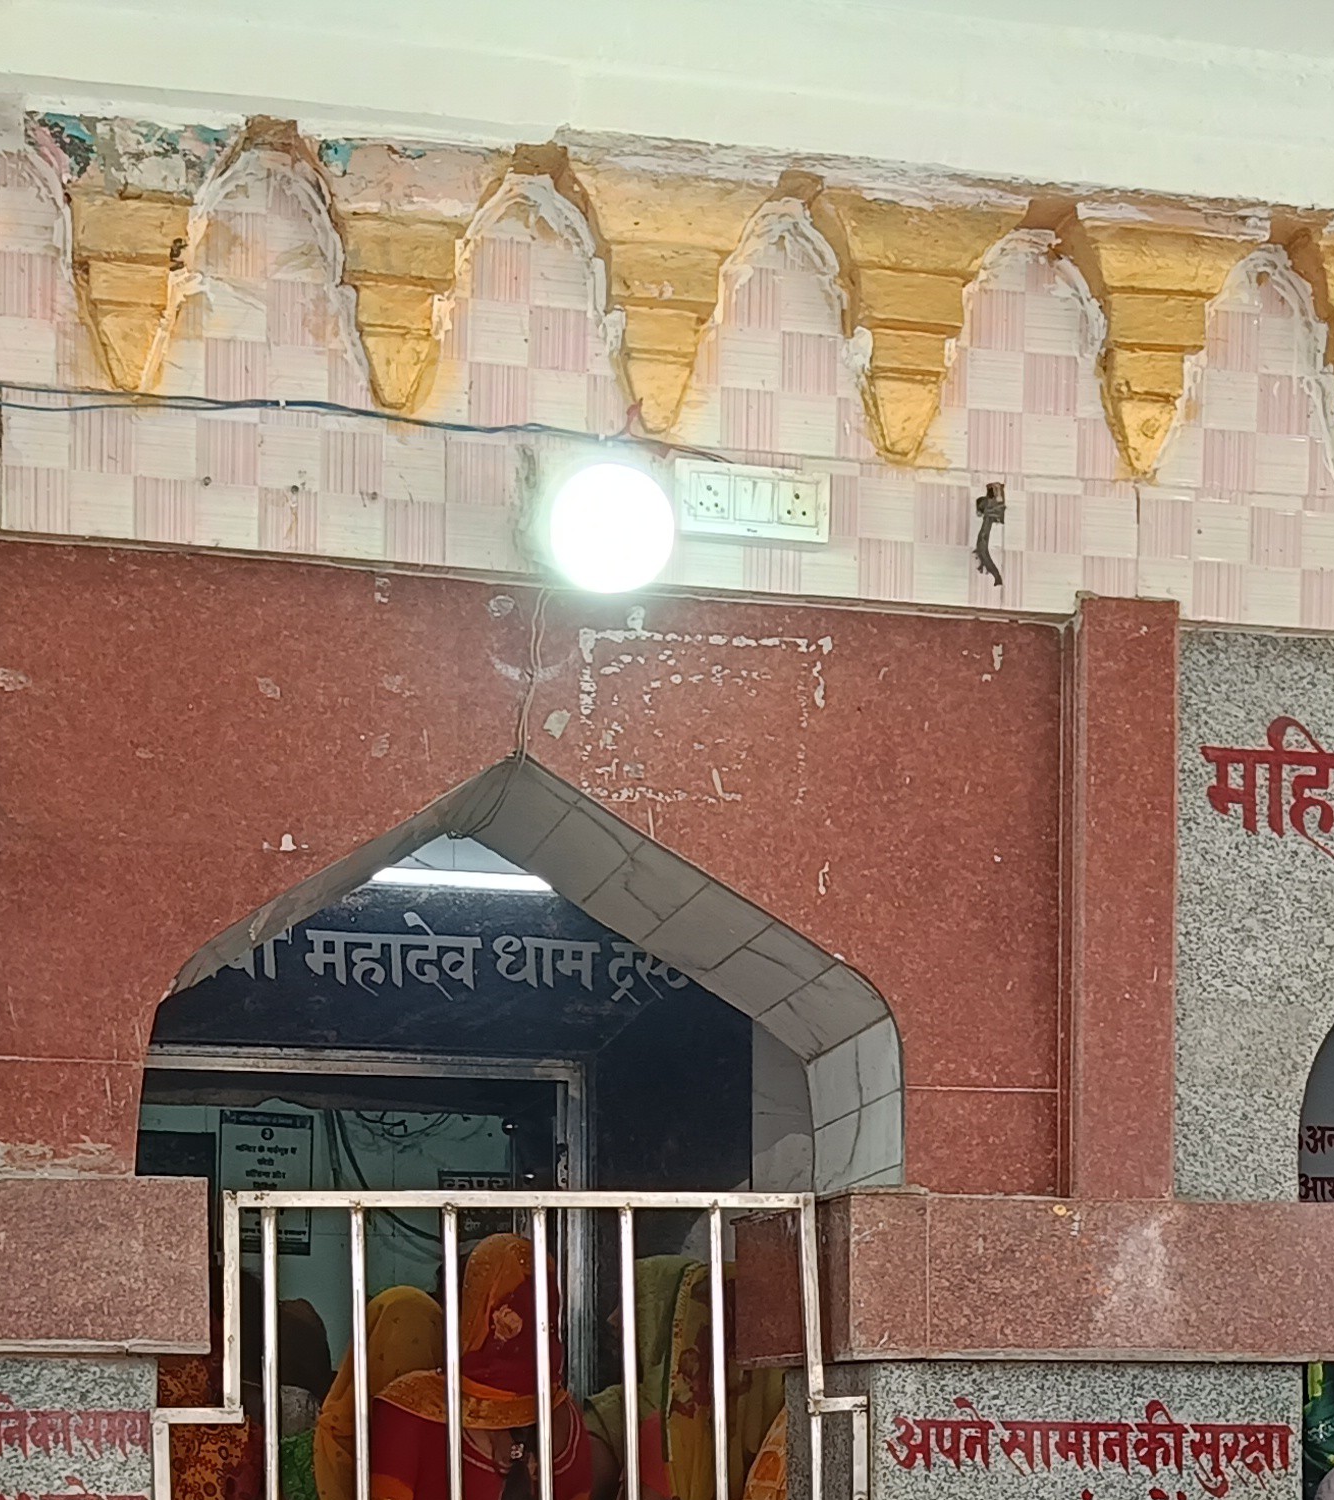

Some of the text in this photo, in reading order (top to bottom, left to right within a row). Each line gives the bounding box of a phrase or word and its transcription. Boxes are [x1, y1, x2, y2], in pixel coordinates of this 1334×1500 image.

[306, 911, 483, 1001] महादेव
[494, 934, 601, 990] धाम
[883, 1396, 996, 1473] अपने
[998, 1420, 1131, 1477] सामान
[1189, 1423, 1294, 1498] सुरक्षा
